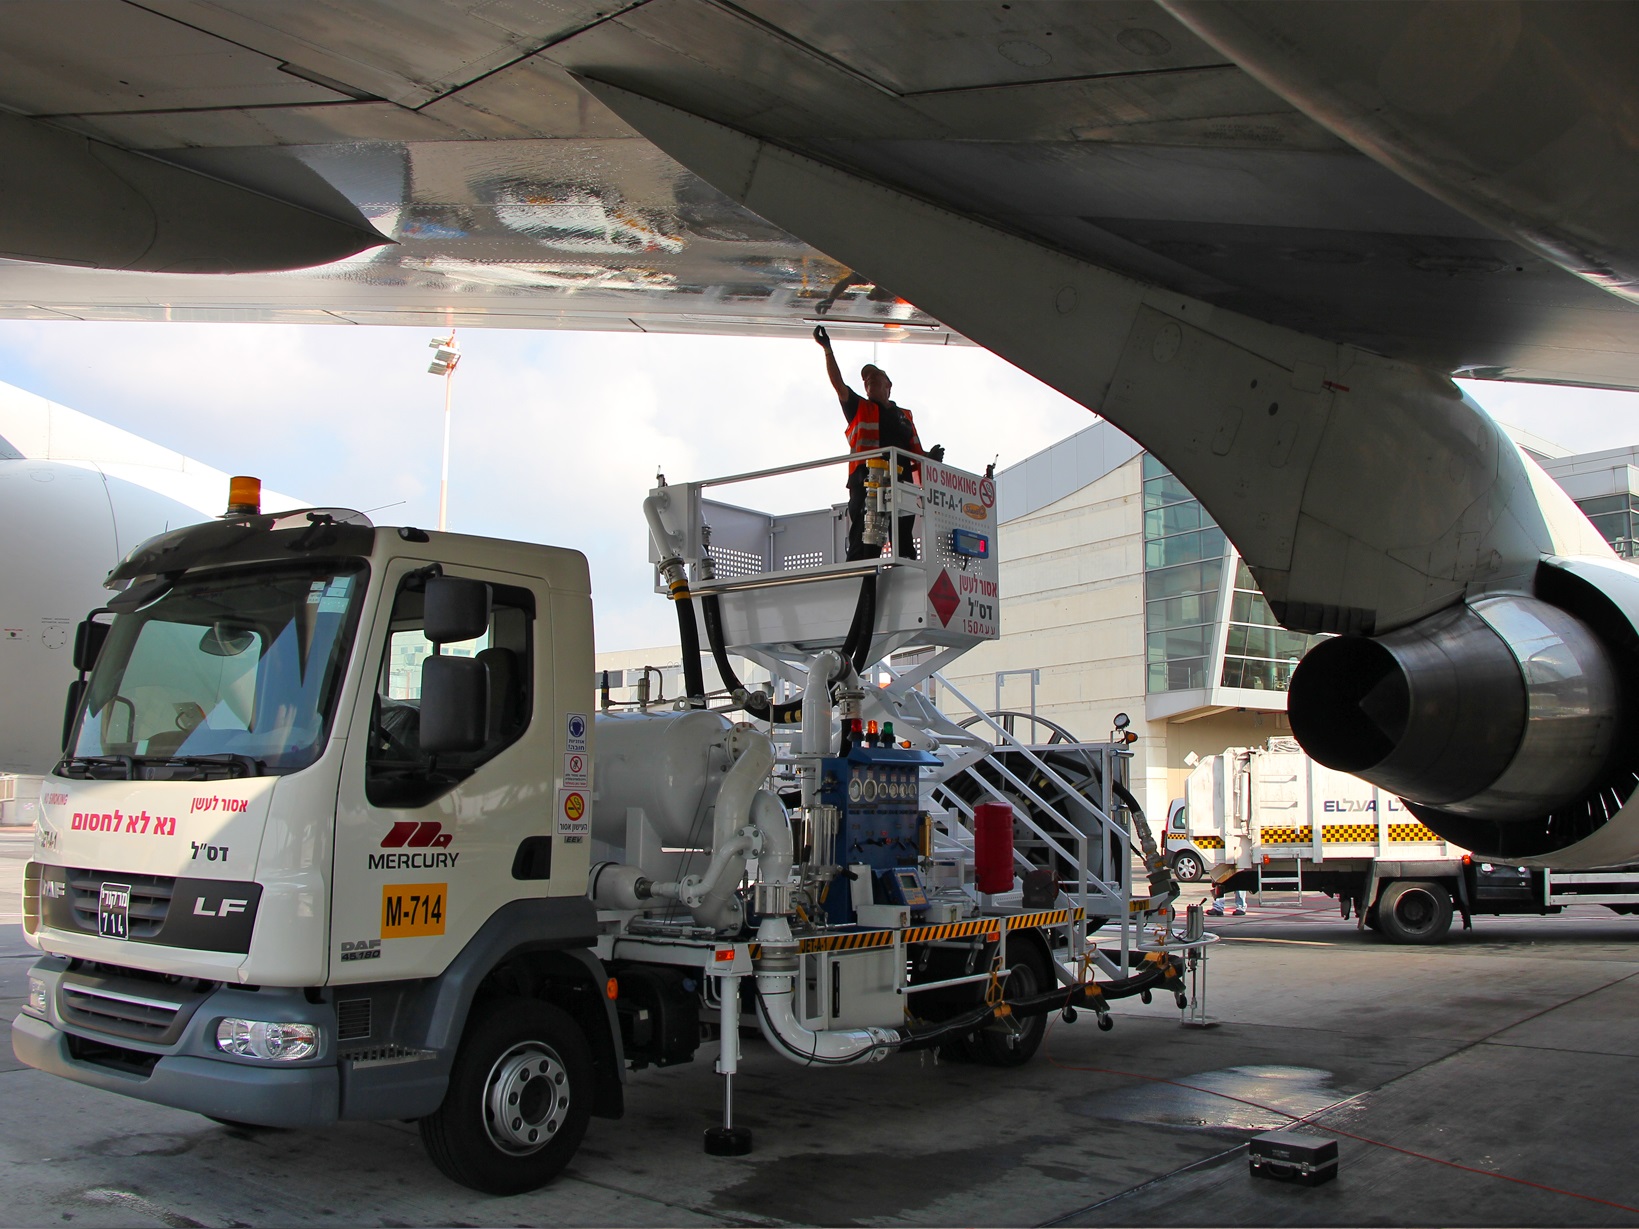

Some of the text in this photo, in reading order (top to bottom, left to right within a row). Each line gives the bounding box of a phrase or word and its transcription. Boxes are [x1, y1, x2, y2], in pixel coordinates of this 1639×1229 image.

[926, 464, 977, 497] NO SMOKING
[926, 488, 963, 513] JET-A-1
[959, 573, 979, 596] לעשן
[979, 578, 998, 598] אסור
[190, 795, 249, 814] אסור לעשן
[71, 809, 177, 836] נא לא לחסום
[368, 852, 460, 870] MERCURY
[193, 897, 249, 917] LF
[385, 894, 442, 927] M-714
[102, 912, 125, 935] 714
[341, 938, 381, 952] DAF
